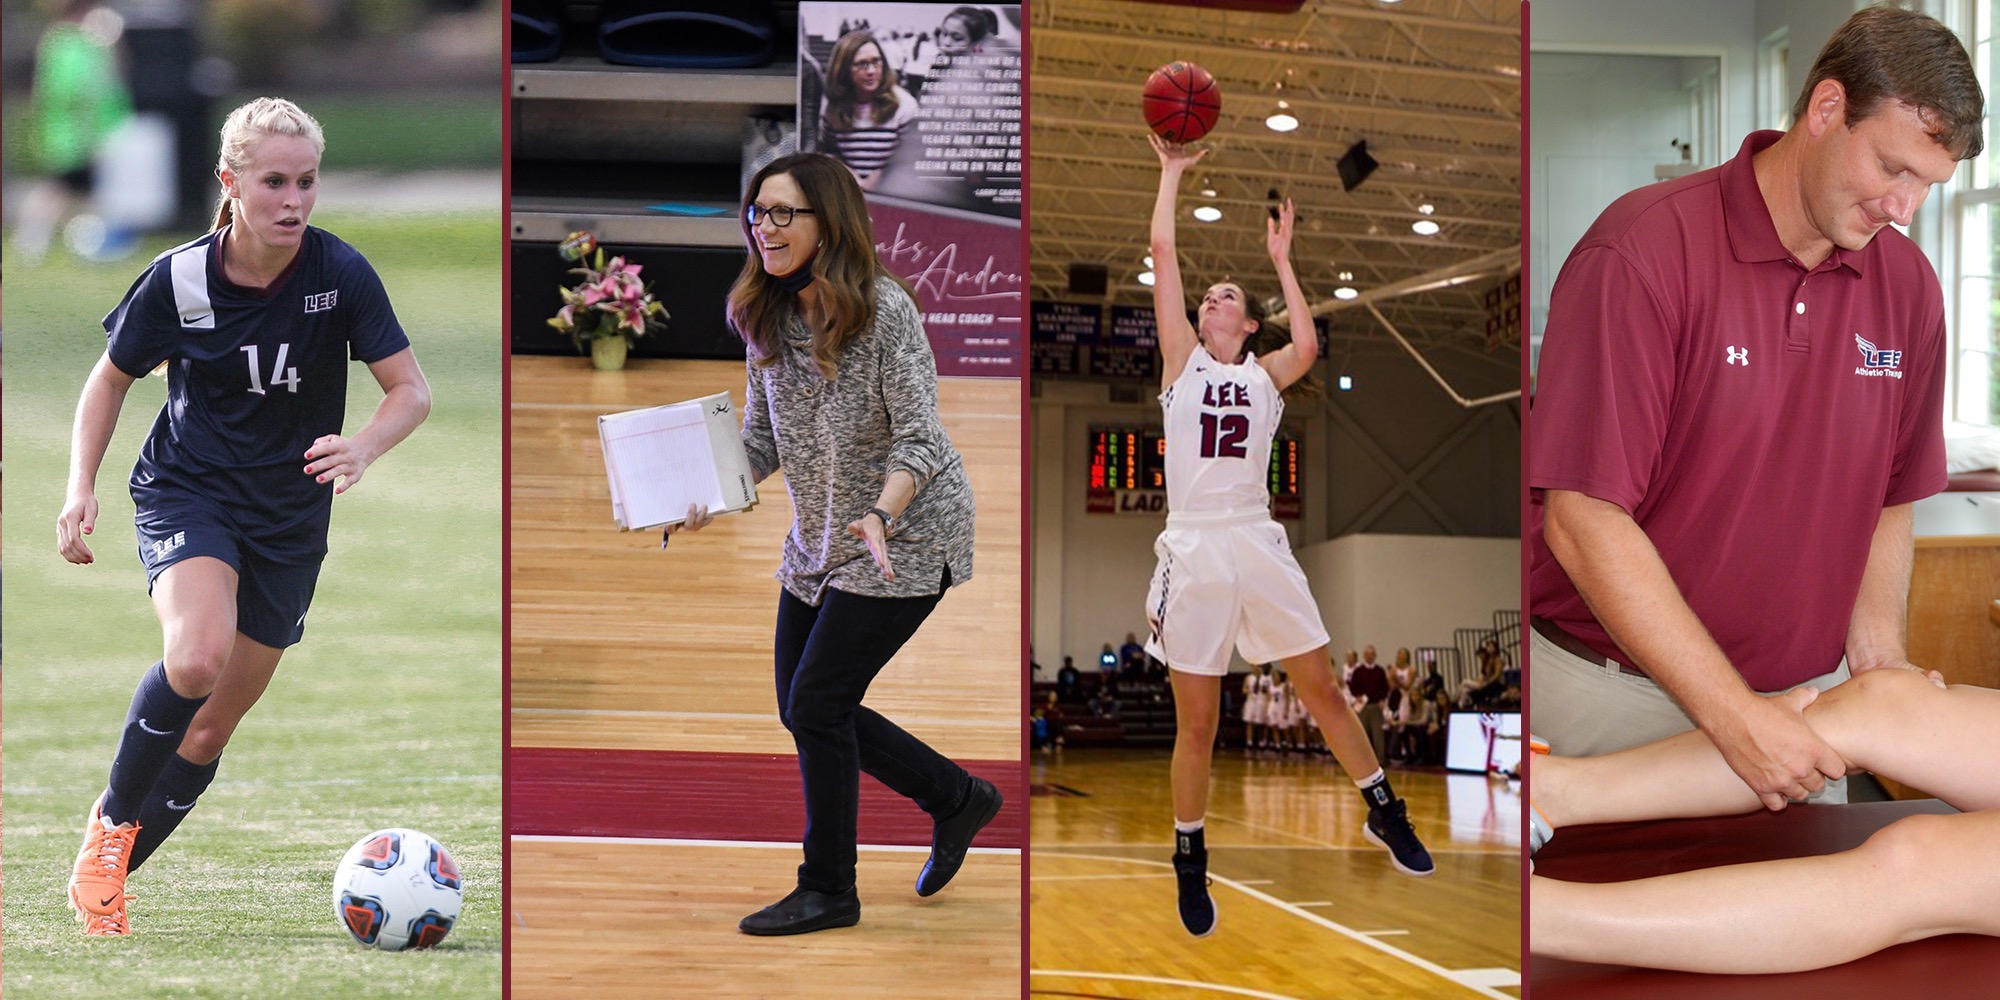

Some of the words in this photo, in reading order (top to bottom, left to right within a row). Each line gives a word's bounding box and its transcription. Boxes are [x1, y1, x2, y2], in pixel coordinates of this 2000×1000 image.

[951, 55, 971, 65] YOU
[973, 56, 1001, 65] THINK
[984, 69, 1001, 78] THE
[921, 81, 959, 91] PERSON
[960, 82, 984, 91] THAT
[985, 82, 1019, 92] COMES
[920, 94, 946, 104] MIND
[947, 95, 958, 104] IS
[959, 95, 990, 105] COACH
[933, 108, 953, 117] HAS
[954, 108, 972, 118] LED
[974, 109, 992, 118] THE
[918, 121, 942, 131] WITH
[943, 122, 1000, 132] EXCELLENCE
[1001, 123, 1020, 132] FOR
[921, 134, 952, 145] YEARS
[952, 135, 973, 145] AND
[974, 135, 984, 145] IT
[985, 135, 1008, 146] WILL
[925, 148, 943, 158] BIG
[943, 148, 1006, 158] ADJUSTMENT
[914, 161, 949, 171] SEEING
[949, 161, 969, 171] HER
[970, 161, 985, 171] ON
[986, 162, 1004, 171] THE
[928, 313, 957, 324] HEAD
[958, 313, 994, 325] COACH
[1865, 349, 1902, 369] LEE
[240, 343, 301, 394] 14
[1855, 367, 1883, 376] Athletic
[1202, 379, 1251, 408] LEE
[1200, 412, 1250, 459] 12
[154, 531, 185, 556] LEE
